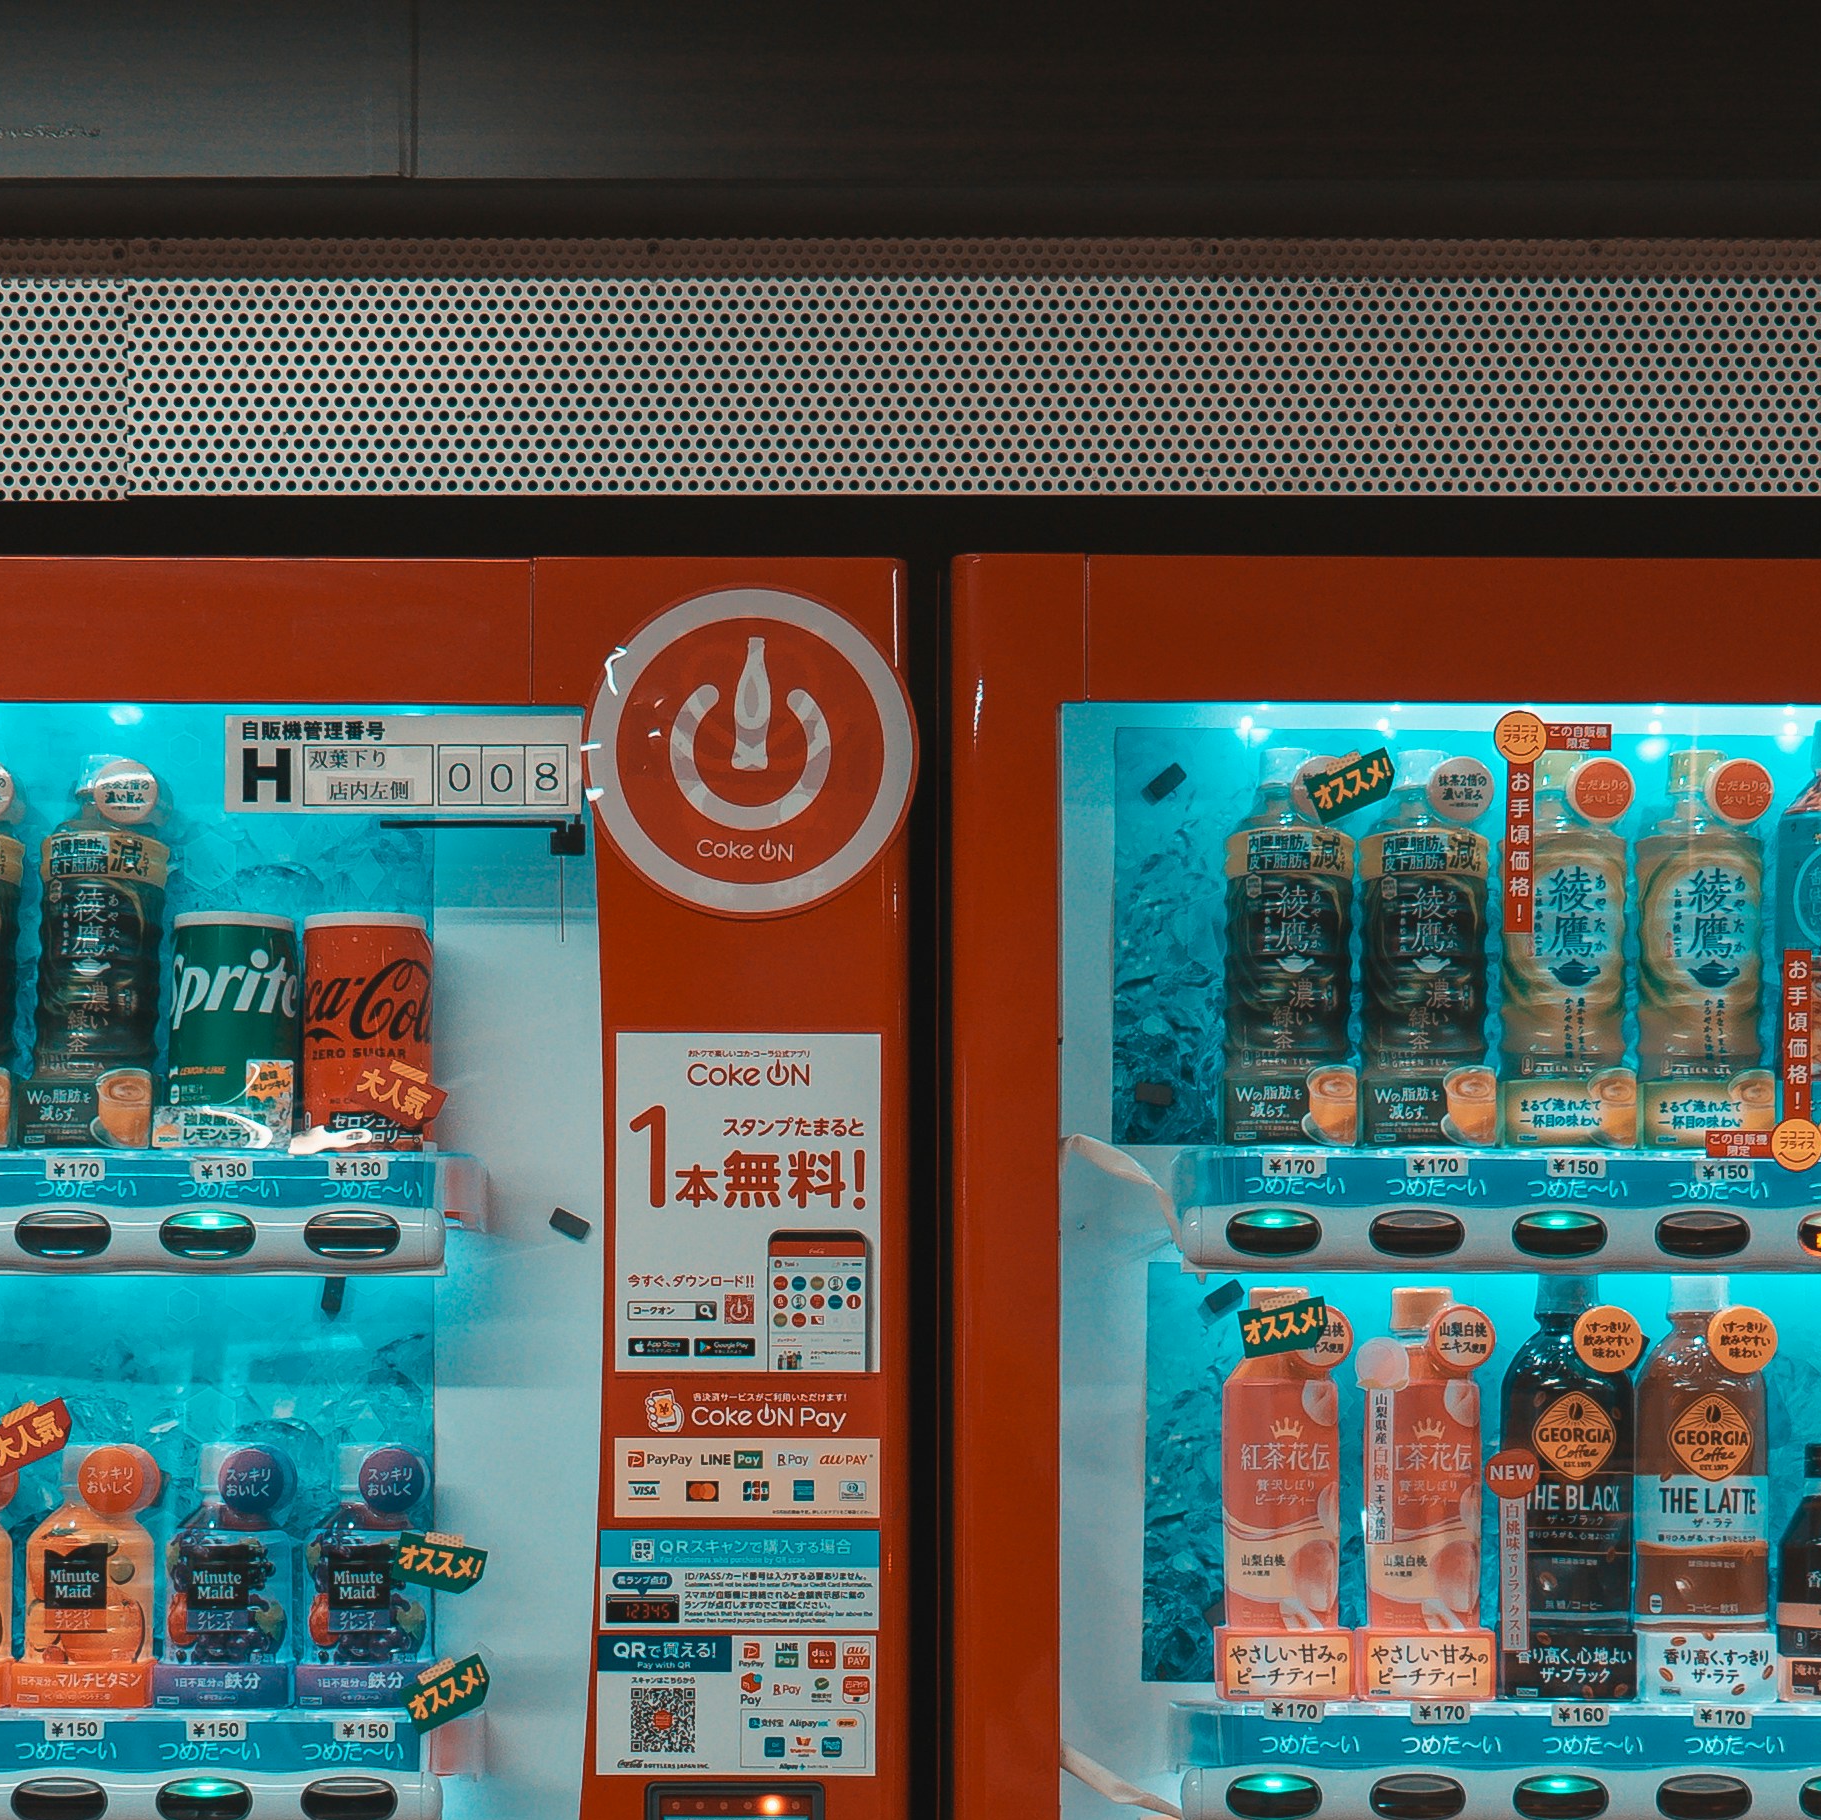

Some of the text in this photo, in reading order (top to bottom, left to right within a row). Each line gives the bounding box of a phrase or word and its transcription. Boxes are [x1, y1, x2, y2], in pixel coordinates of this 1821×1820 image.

[241, 720, 385, 741] 自販機管理番号
[309, 749, 387, 769] 双葉下り
[243, 748, 292, 803] H
[327, 777, 410, 800] 店内左側
[696, 838, 754, 862] Coke
[687, 1062, 760, 1086] Coke
[356, 1068, 430, 1119] 大人気
[722, 1118, 865, 1137] スタンプたまると
[629, 1104, 866, 1210] 1本無料!
[200, 1162, 247, 1178] ¥130
[632, 1306, 676, 1315] コークオン
[1243, 1306, 1326, 1346] オススメ!
[692, 1406, 753, 1427] Coke
[800, 1406, 847, 1432] Pay
[1538, 1427, 1613, 1446] GEORGIA
[647, 1453, 693, 1466] PayPay
[700, 1454, 760, 1466] LINE Pay
[1240, 1444, 1331, 1471] 紅茶花伝
[86, 1466, 134, 1480] スッキリ
[1489, 1464, 1534, 1482] NEW
[86, 1481, 134, 1495] おいしく
[633, 1486, 657, 1495] VISA
[396, 1544, 483, 1580] オススメ!
[613, 1641, 717, 1659] QRで買える!
[1228, 1647, 1348, 1667] やさしい甘みの
[407, 1664, 488, 1720] オススメ!
[1271, 1702, 1318, 1720] ¥170
[193, 1722, 240, 1737] ¥150
